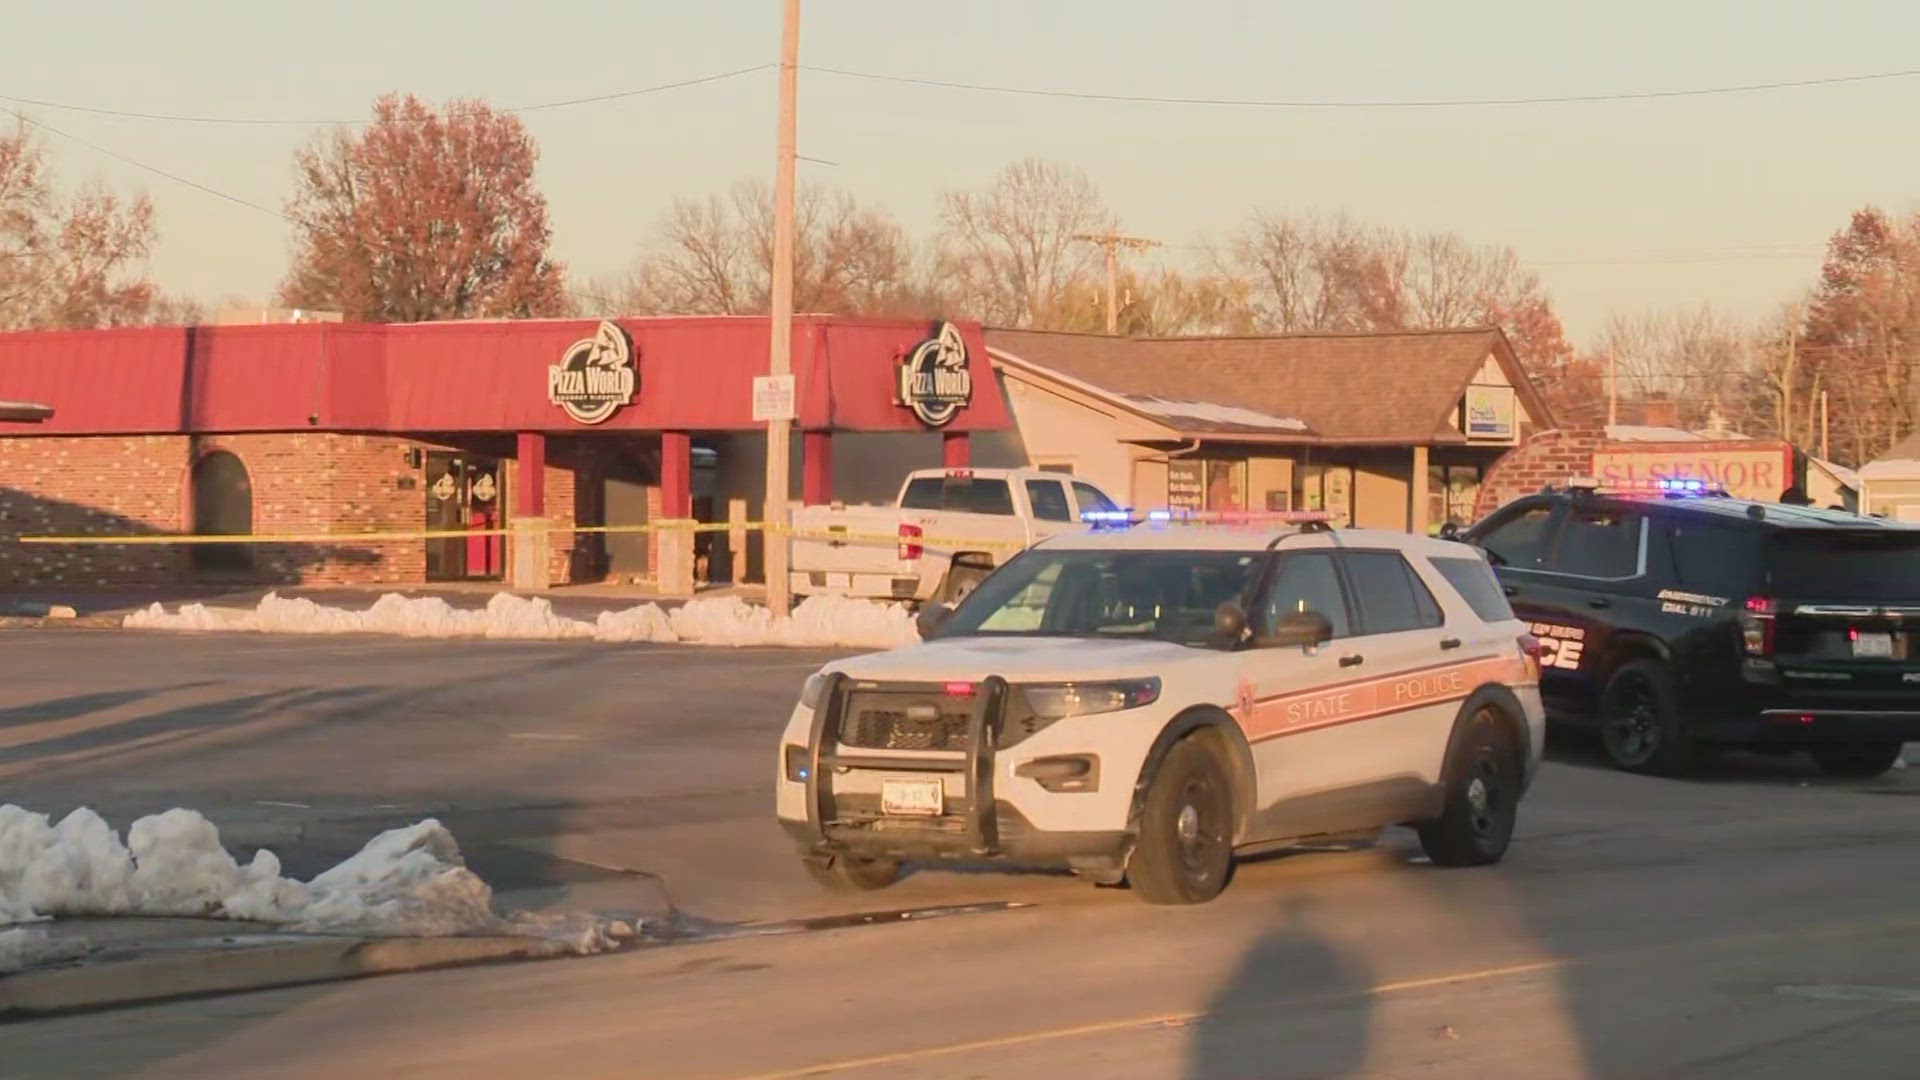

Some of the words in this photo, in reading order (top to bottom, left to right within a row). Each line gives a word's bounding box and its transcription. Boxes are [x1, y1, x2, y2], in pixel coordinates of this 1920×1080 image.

[548, 365, 586, 401] PIZZA
[585, 366, 634, 398] WORLD
[902, 365, 934, 400] PIZZA
[934, 367, 970, 398] WORLD
[1286, 693, 1351, 724] STATE
[1394, 671, 1463, 703] POLICE
